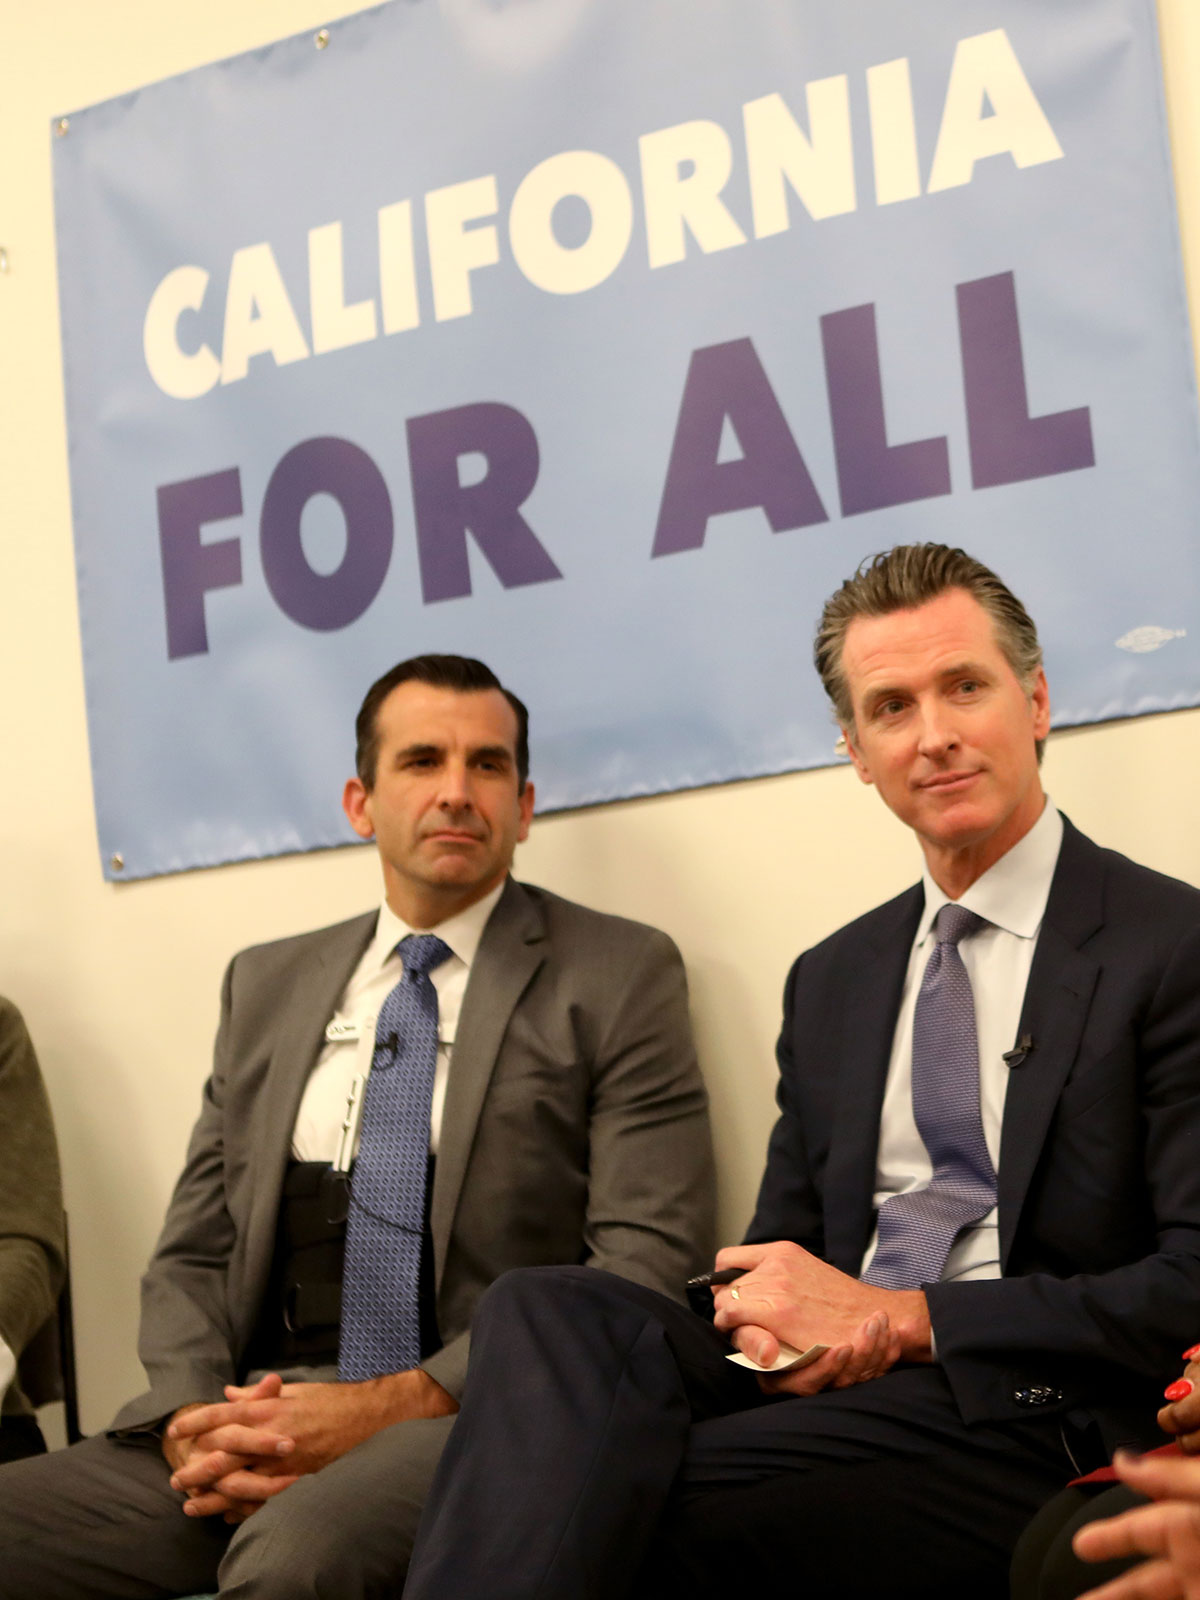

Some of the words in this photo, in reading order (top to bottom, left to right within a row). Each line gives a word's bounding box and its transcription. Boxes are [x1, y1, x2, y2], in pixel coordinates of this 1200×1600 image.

[143, 28, 1065, 400] CALIFORNIA
[156, 401, 564, 661] FOR
[651, 270, 1096, 559] ALL
